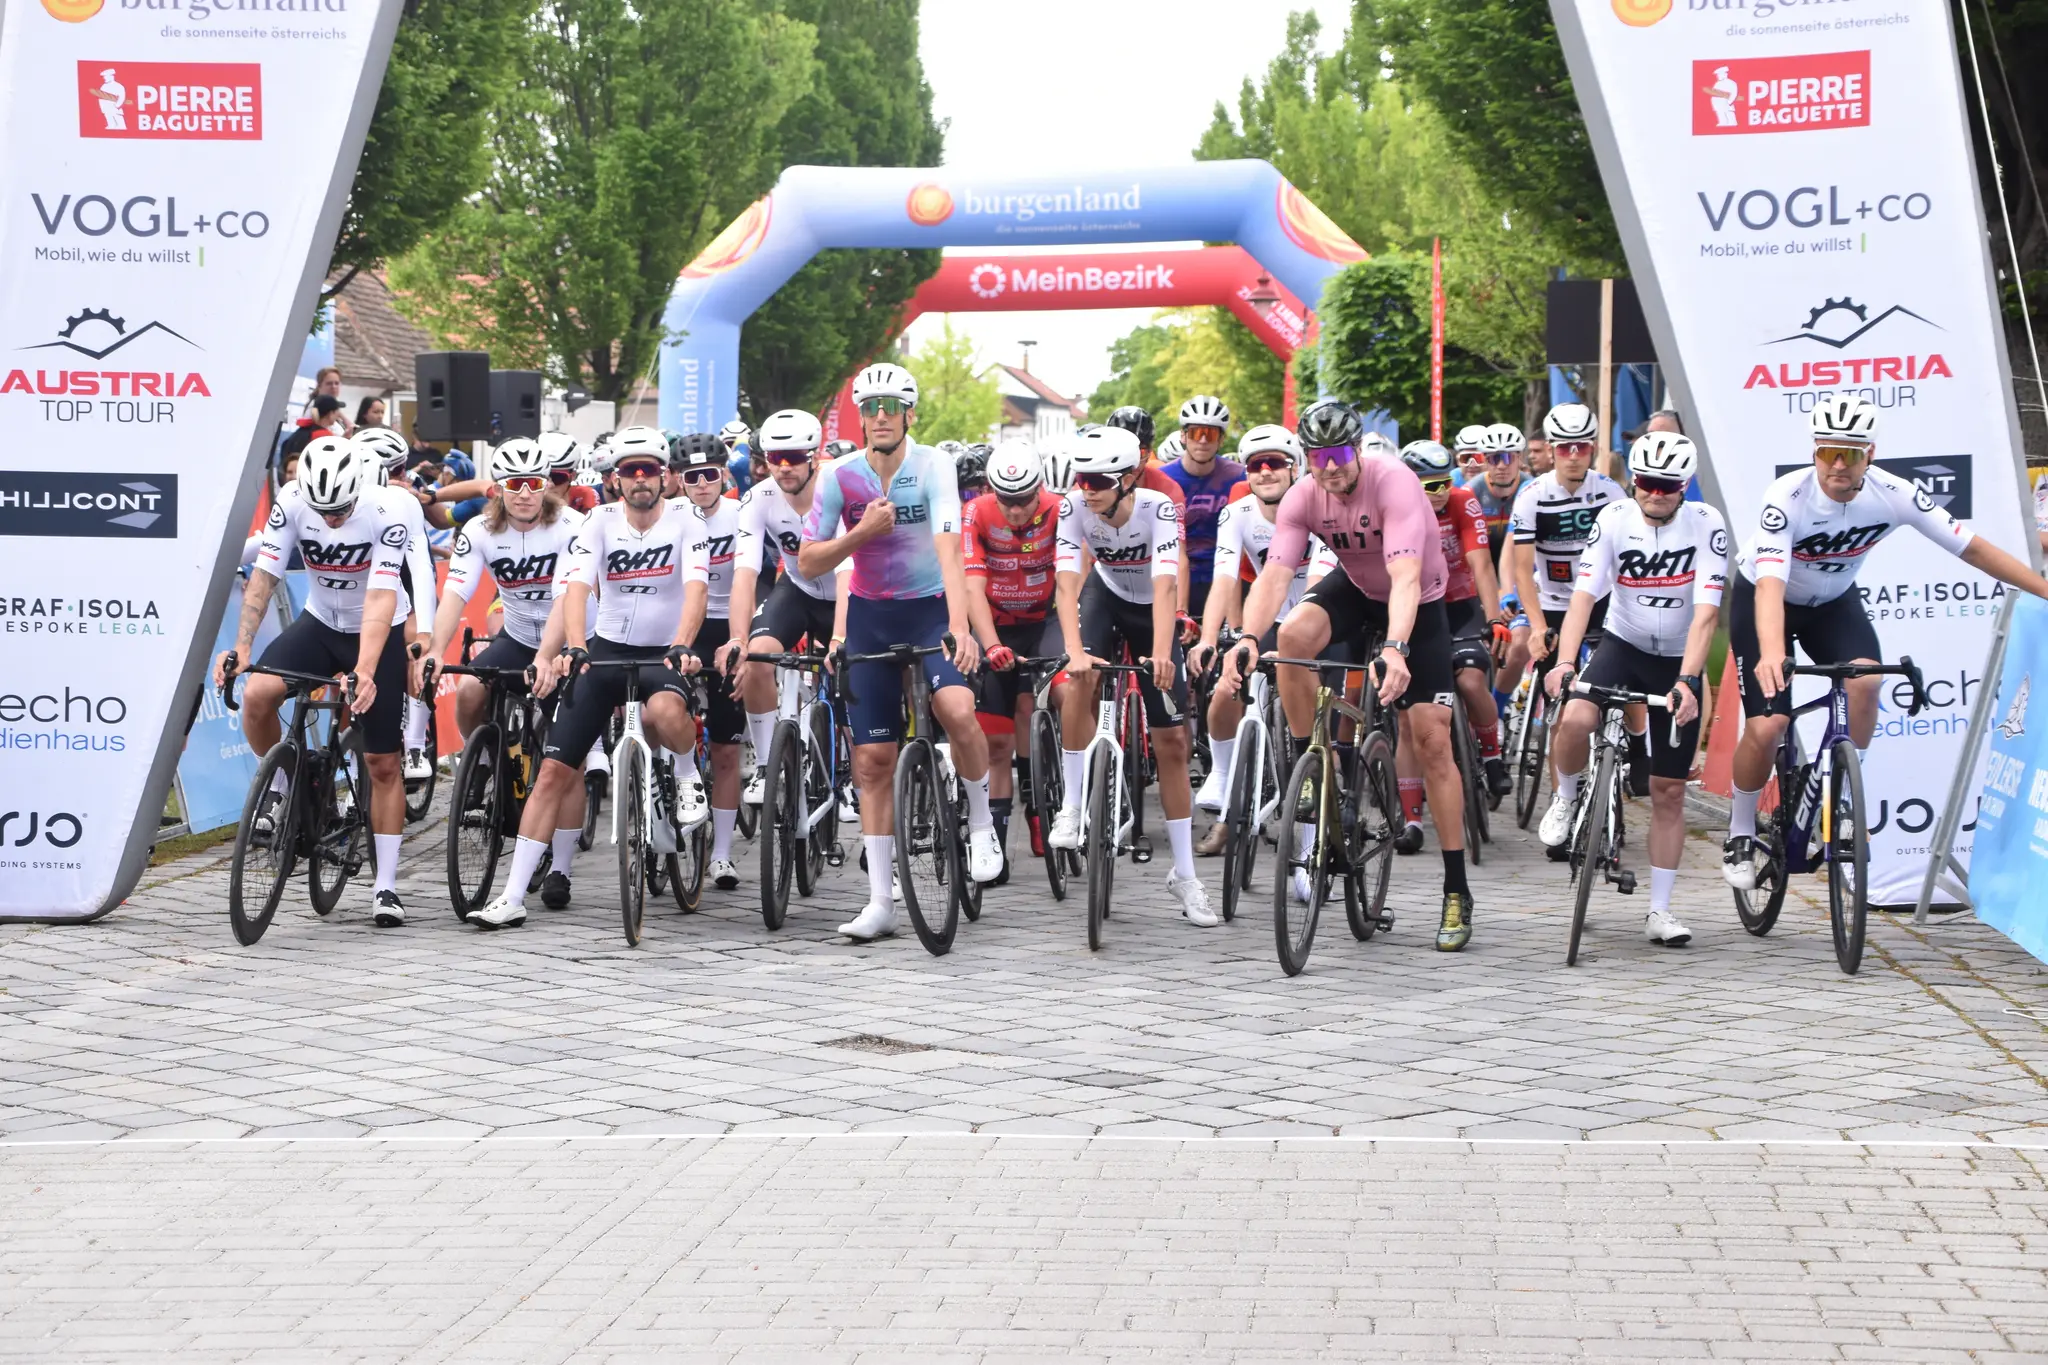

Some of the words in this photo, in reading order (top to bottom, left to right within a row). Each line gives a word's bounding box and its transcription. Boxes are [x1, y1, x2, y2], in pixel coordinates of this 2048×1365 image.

[161, 25, 182, 38] die
[185, 26, 268, 39] sonnenseite
[271, 26, 347, 40] österreichs
[1726, 26, 1747, 37] die
[1750, 20, 1831, 36] sonnenseite
[1834, 13, 1910, 29] österreichs
[137, 85, 253, 112] PIERRE
[1748, 73, 1862, 106] PIERRE
[138, 115, 254, 132] BAGUETTE
[1749, 102, 1862, 126] BAGUETTE
[964, 183, 1142, 222] burgenland
[121, 248, 143, 263] du
[148, 248, 191, 263] willst
[1784, 239, 1805, 254] du
[1810, 237, 1852, 253] willst
[1011, 264, 1175, 292] MeinBezirk
[0, 369, 212, 397] AUSTRIA
[1743, 354, 1954, 390] AUSTRIA
[39, 399, 93, 422] TOP
[100, 400, 175, 424] TOUR
[642, 567, 670, 578] RACING
[1661, 573, 1695, 585] RACING
[99, 622, 165, 635] LEGAL
[1892, 670, 2001, 708] ech
[0, 686, 127, 725] echo
[1102, 703, 1110, 731] BMC
[1836, 695, 1846, 726] BMC
